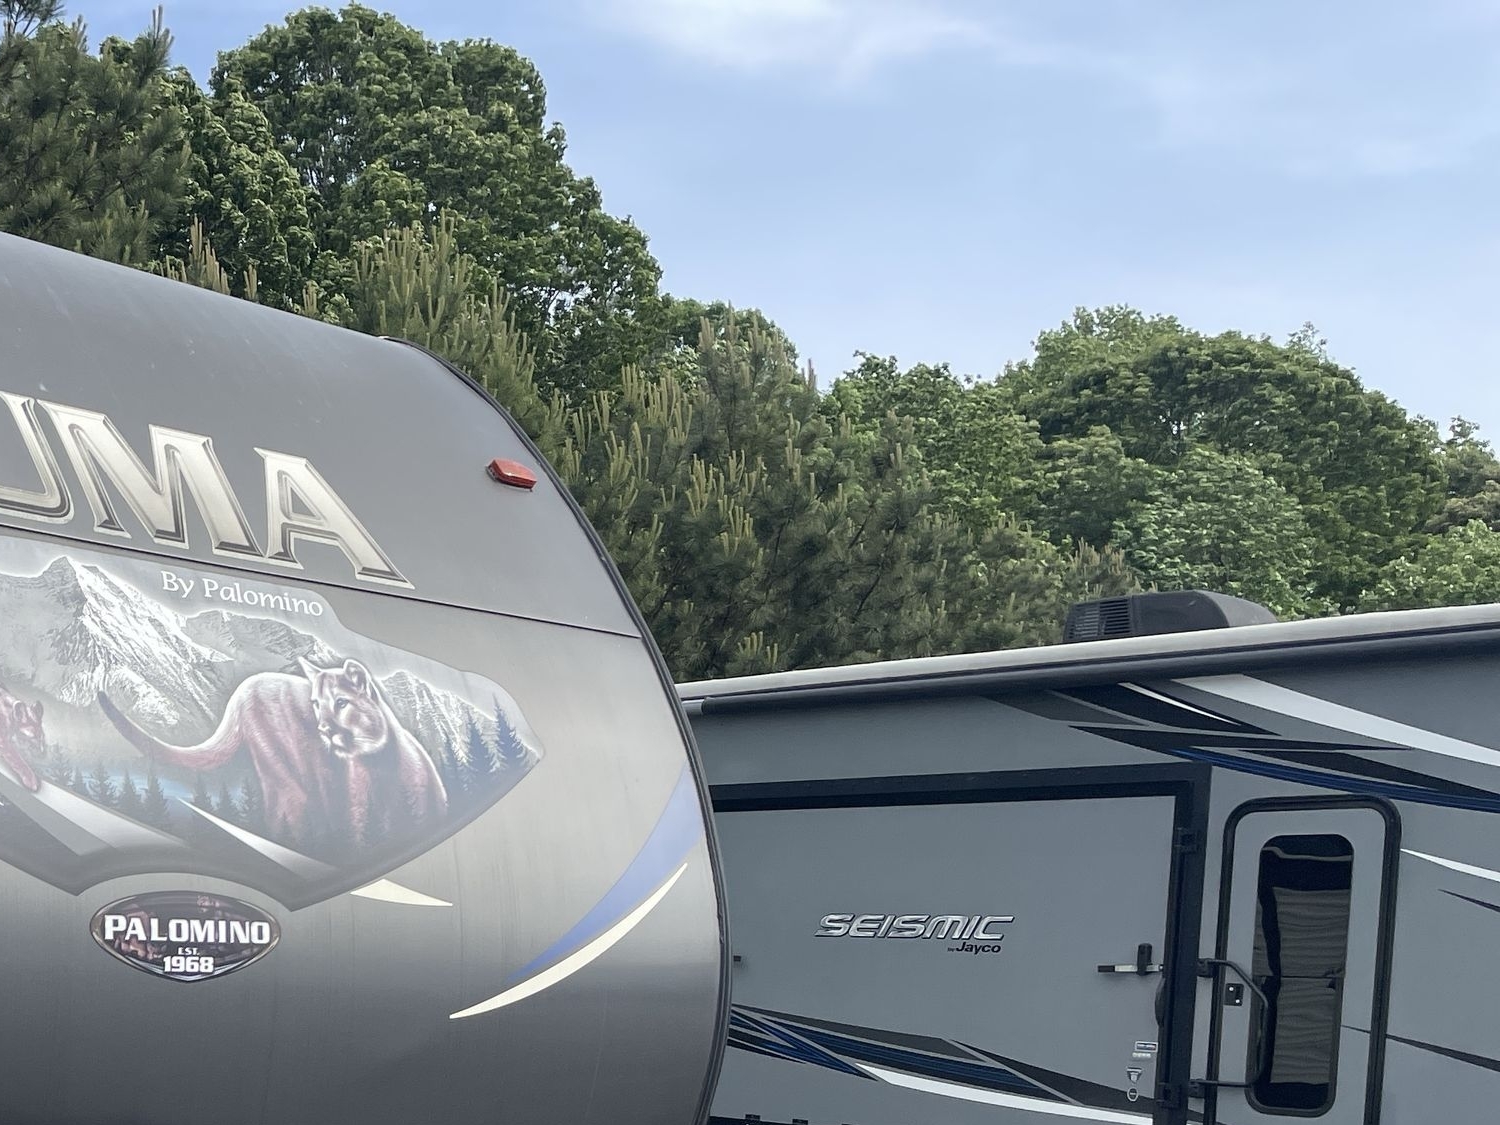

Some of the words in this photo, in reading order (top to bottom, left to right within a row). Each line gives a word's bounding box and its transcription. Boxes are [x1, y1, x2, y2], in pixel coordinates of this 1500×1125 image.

[160, 570, 195, 599] By
[202, 577, 324, 617] Palomino
[103, 914, 271, 945] PALOMINO
[814, 912, 1015, 941] SEISMIC
[956, 941, 1002, 955] Jayco
[163, 955, 215, 974] 1968
